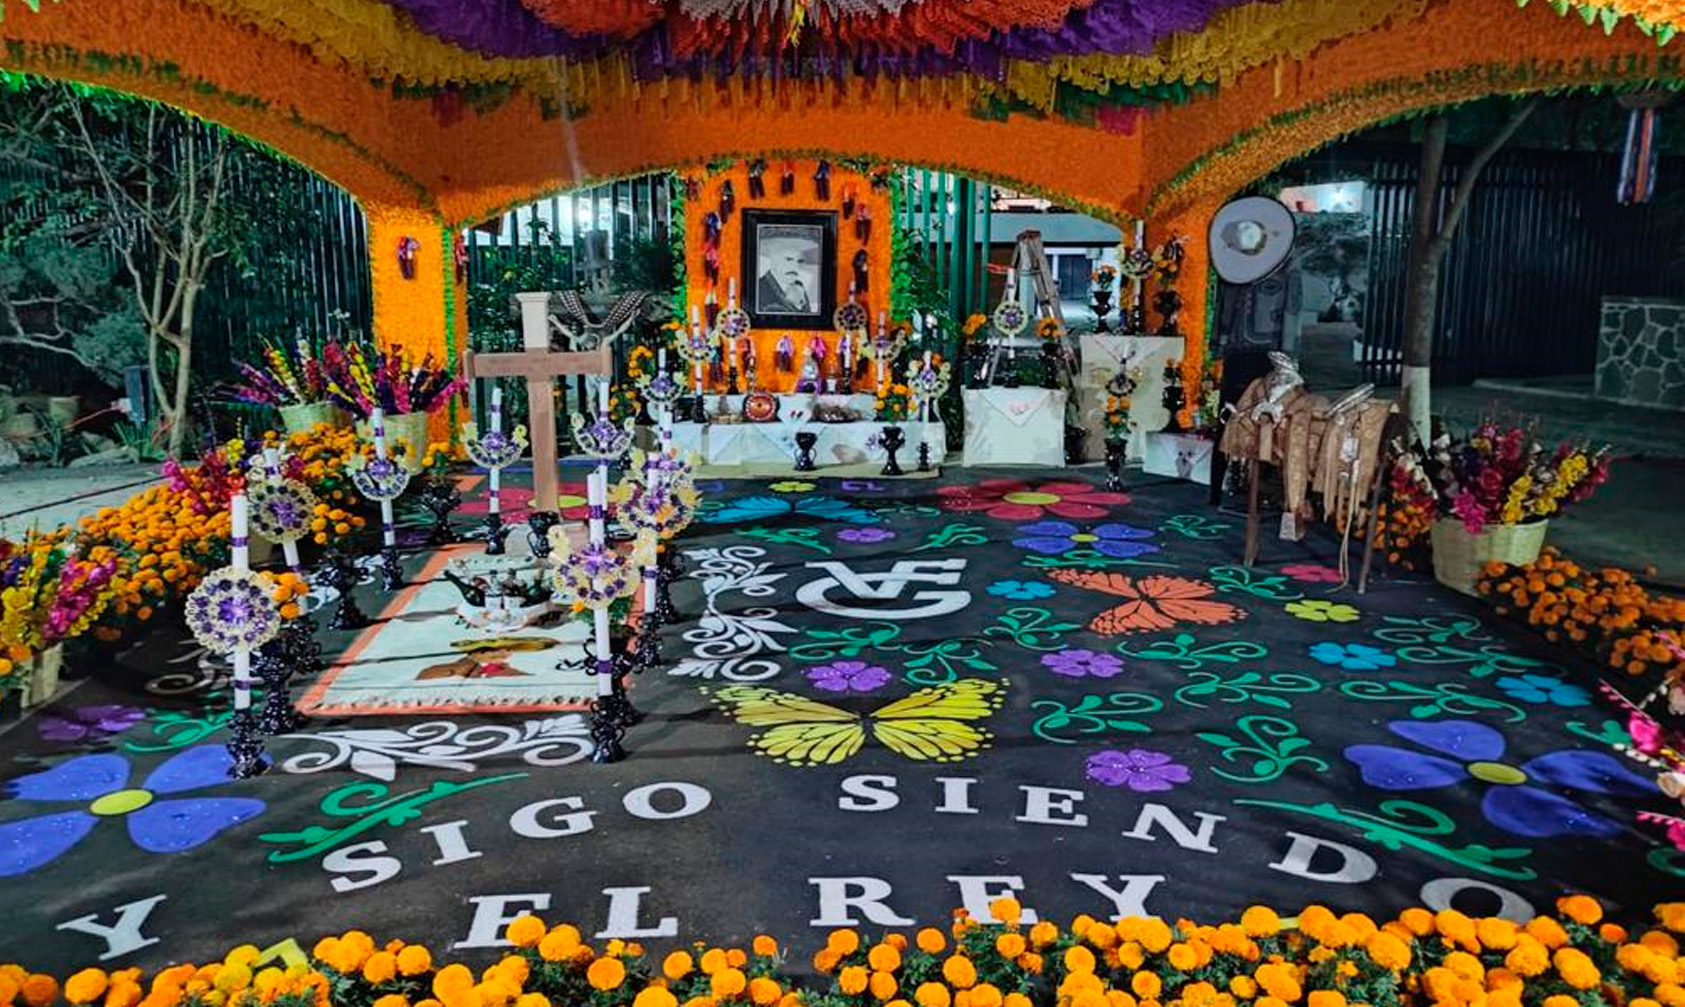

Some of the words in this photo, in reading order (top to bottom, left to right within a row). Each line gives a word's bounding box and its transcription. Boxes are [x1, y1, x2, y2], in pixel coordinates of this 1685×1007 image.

[57, 894, 167, 960] Y
[321, 780, 713, 893] SIGO
[838, 774, 1536, 927] SIENDO
[453, 885, 679, 949] EL
[808, 873, 1166, 926] REY
